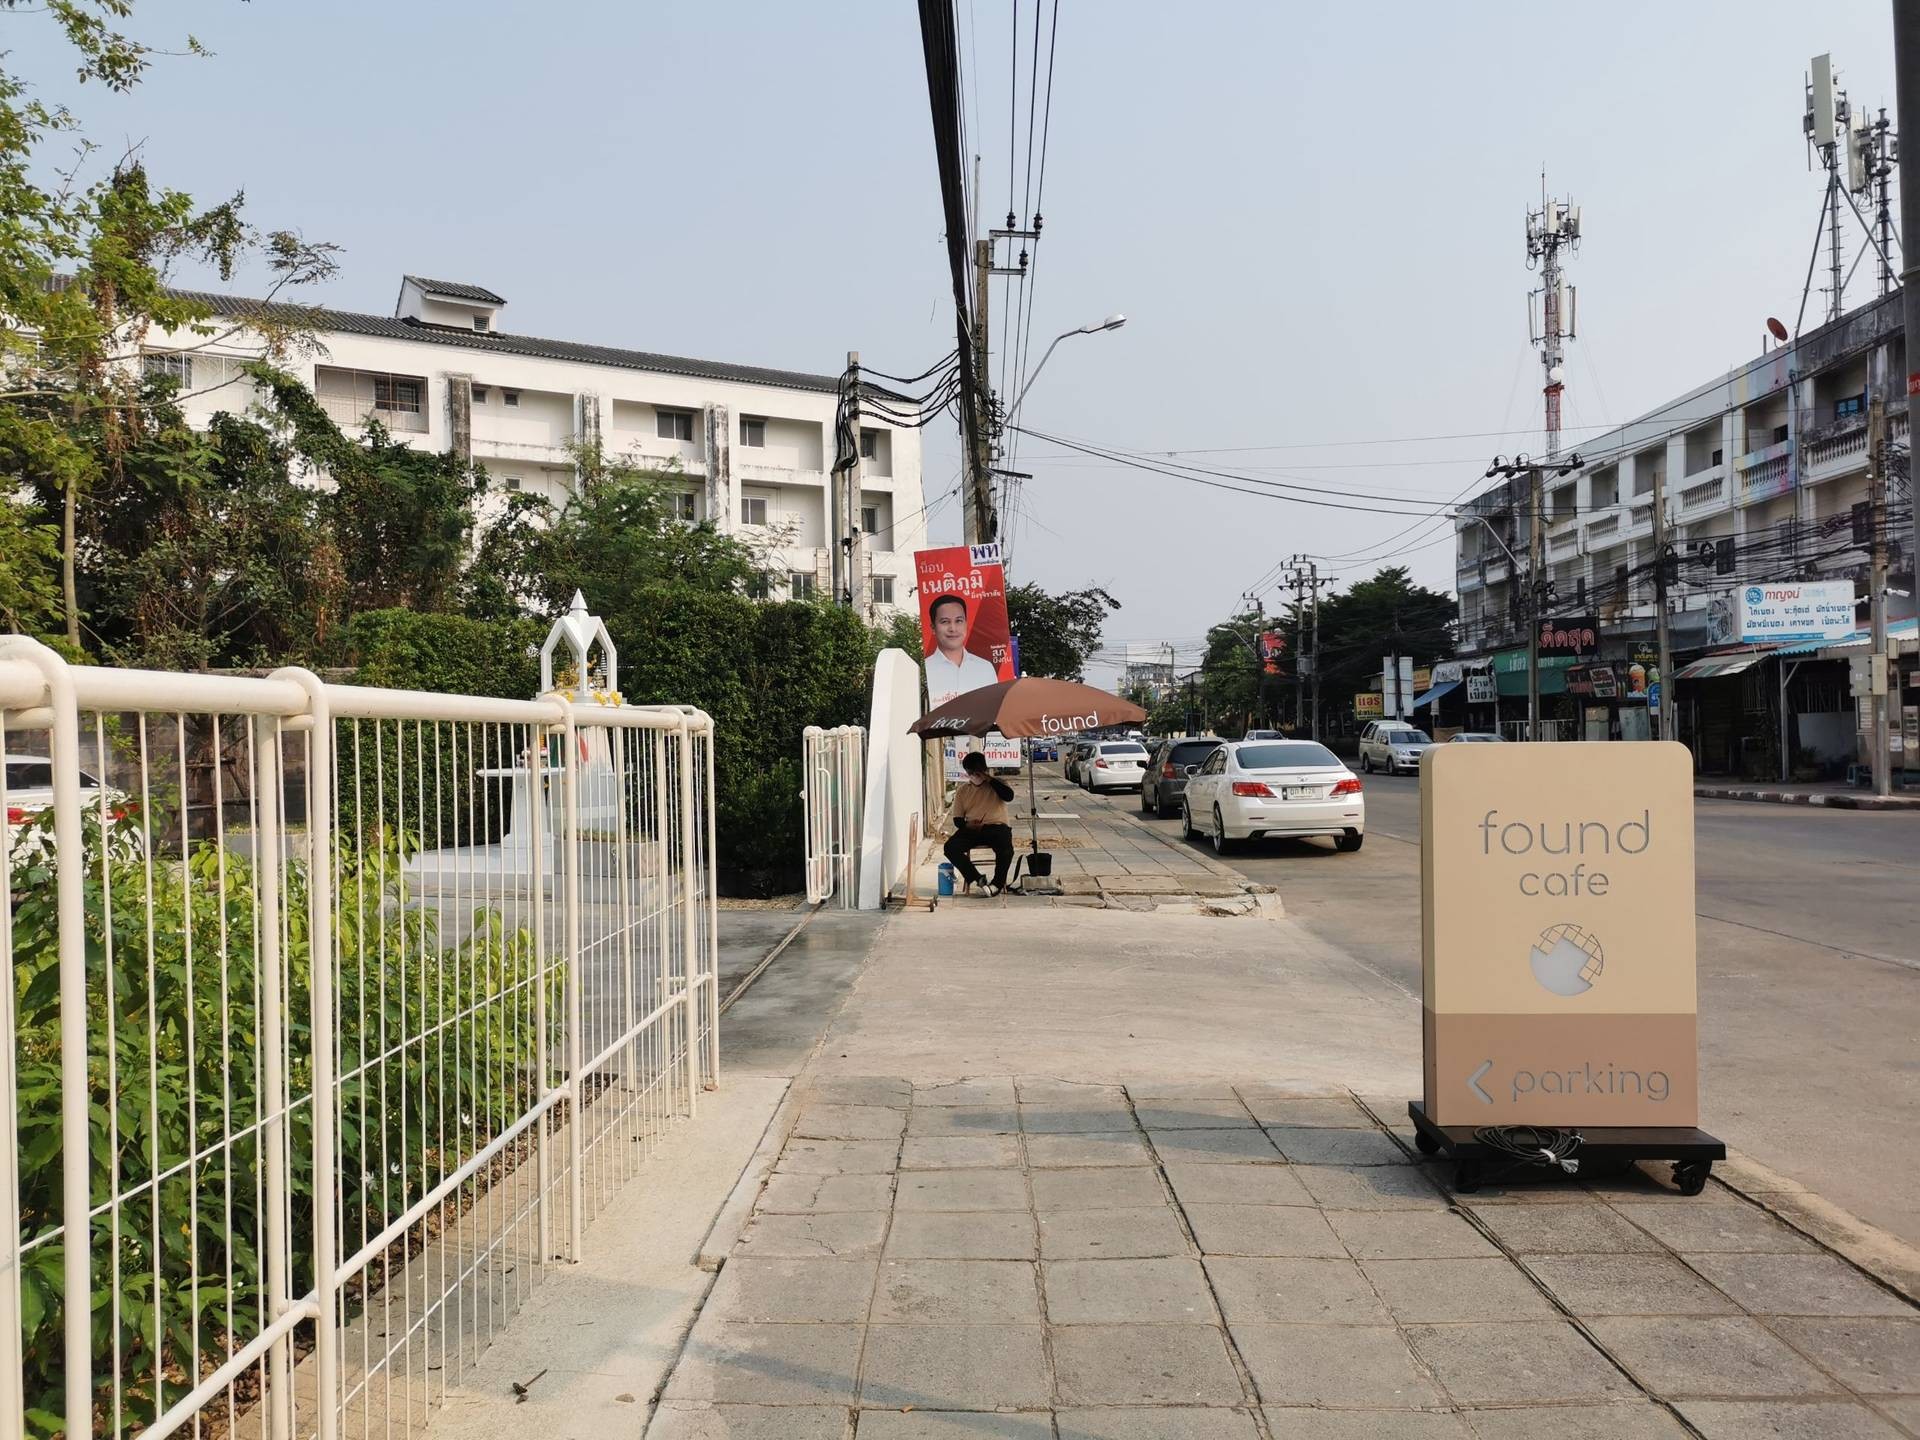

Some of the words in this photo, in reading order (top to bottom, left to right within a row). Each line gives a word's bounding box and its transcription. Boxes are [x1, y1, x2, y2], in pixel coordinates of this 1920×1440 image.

[922, 569, 983, 596] เนติภูมิ
[1041, 711, 1099, 733] found
[1478, 808, 1650, 855] found
[1519, 863, 1609, 897] cafe
[1512, 1062, 1670, 1102] parking
